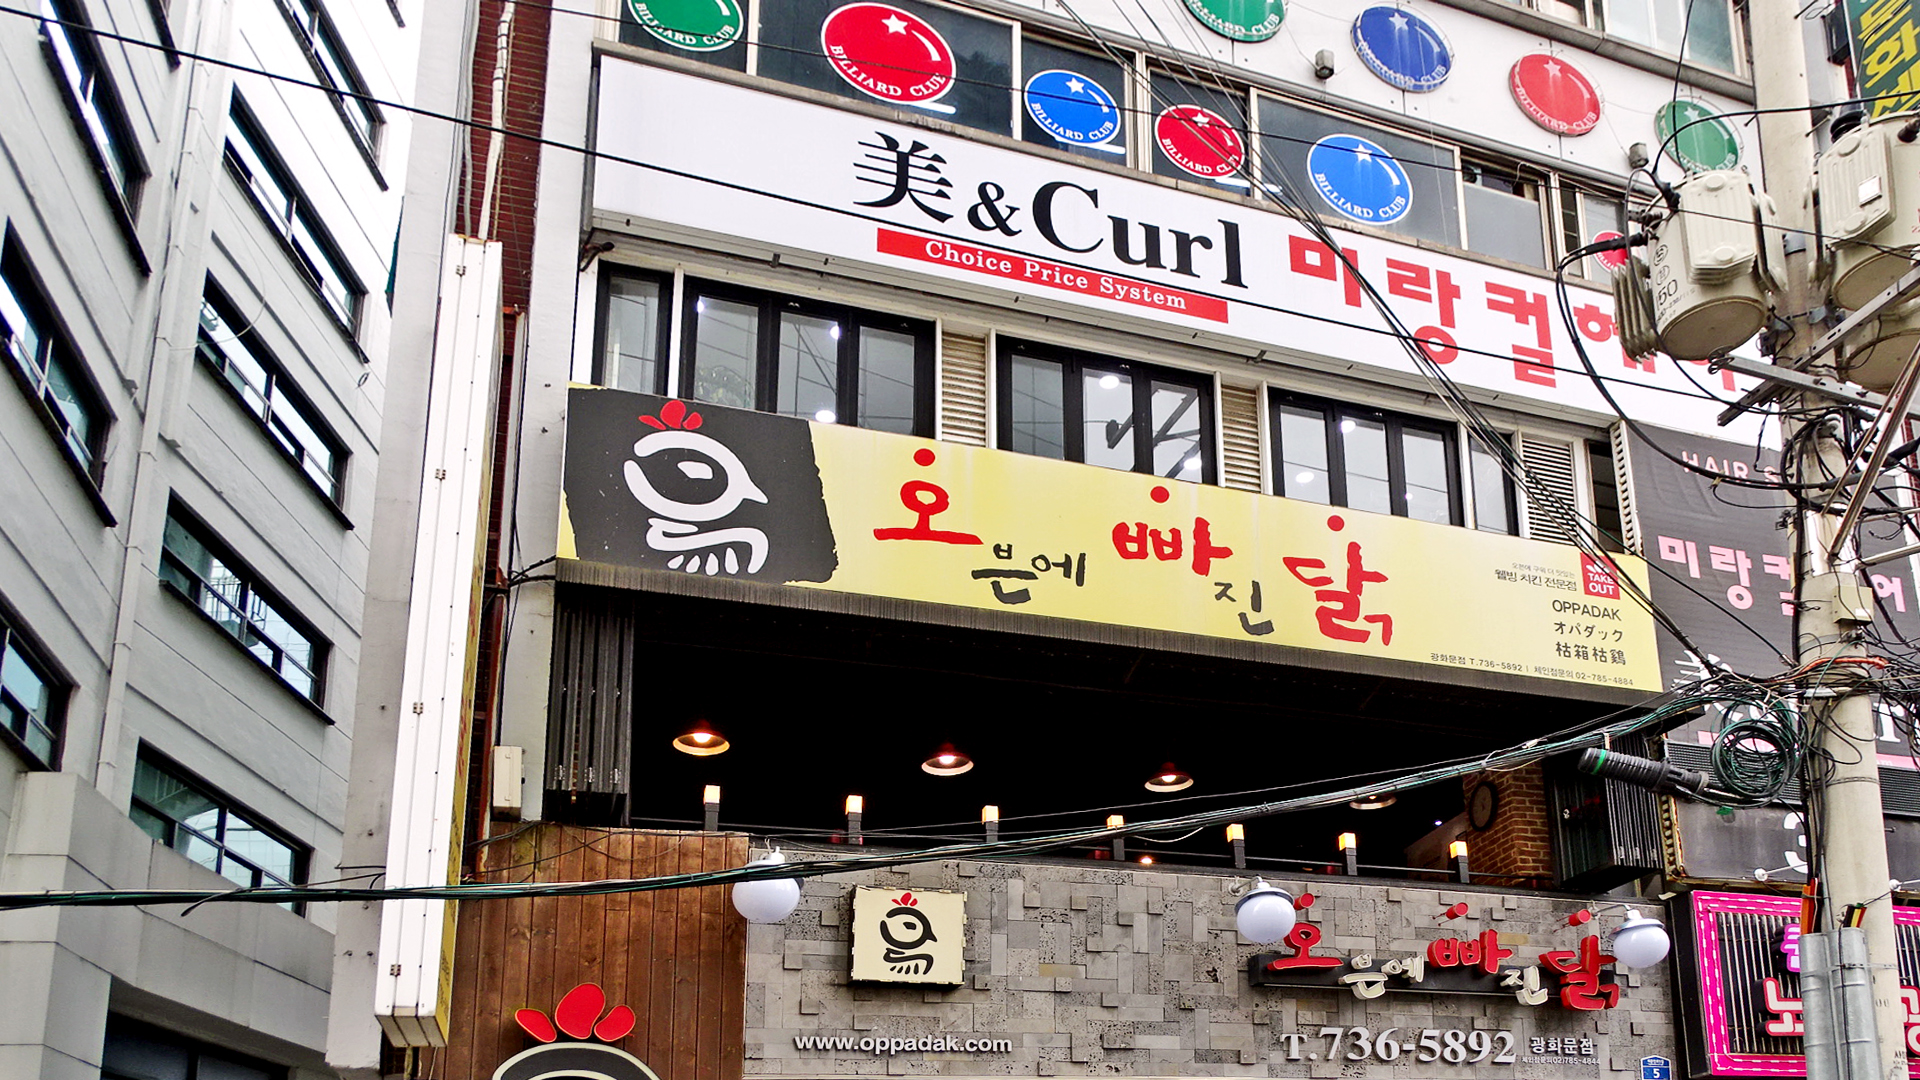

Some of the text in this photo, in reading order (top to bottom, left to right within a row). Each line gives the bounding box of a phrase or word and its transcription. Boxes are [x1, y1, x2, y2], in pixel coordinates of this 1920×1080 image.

[702, 24, 735, 45] CLUB
[1251, 13, 1280, 35] CLUB
[830, 44, 902, 97] BILLIARD
[1030, 102, 1115, 141] BILLIARD CLUB
[1573, 111, 1597, 130] CLUB
[1161, 137, 1213, 174] BILLIARD
[1314, 172, 1406, 219] BILLIARD CLUB
[853, 131, 1248, 290] 美 & Curl
[925, 240, 1187, 311] Choice Price System
[1283, 515, 1393, 647] 닭
[1520, 573, 1543, 587] 치킨
[1544, 576, 1578, 592] 전문점
[1587, 572, 1615, 585] TAKE
[1588, 582, 1616, 596] OUT
[1551, 599, 1622, 622] OPPADAK
[1430, 652, 1467, 665] 광화문점
[1469, 656, 1524, 673] T.736-5892
[1538, 909, 1622, 1011] 닭
[793, 1034, 1013, 1055] www.oppadak.com
[1280, 1026, 1595, 1064] T.736-5892 광화문점
[1652, 1068, 1661, 1079] 5
